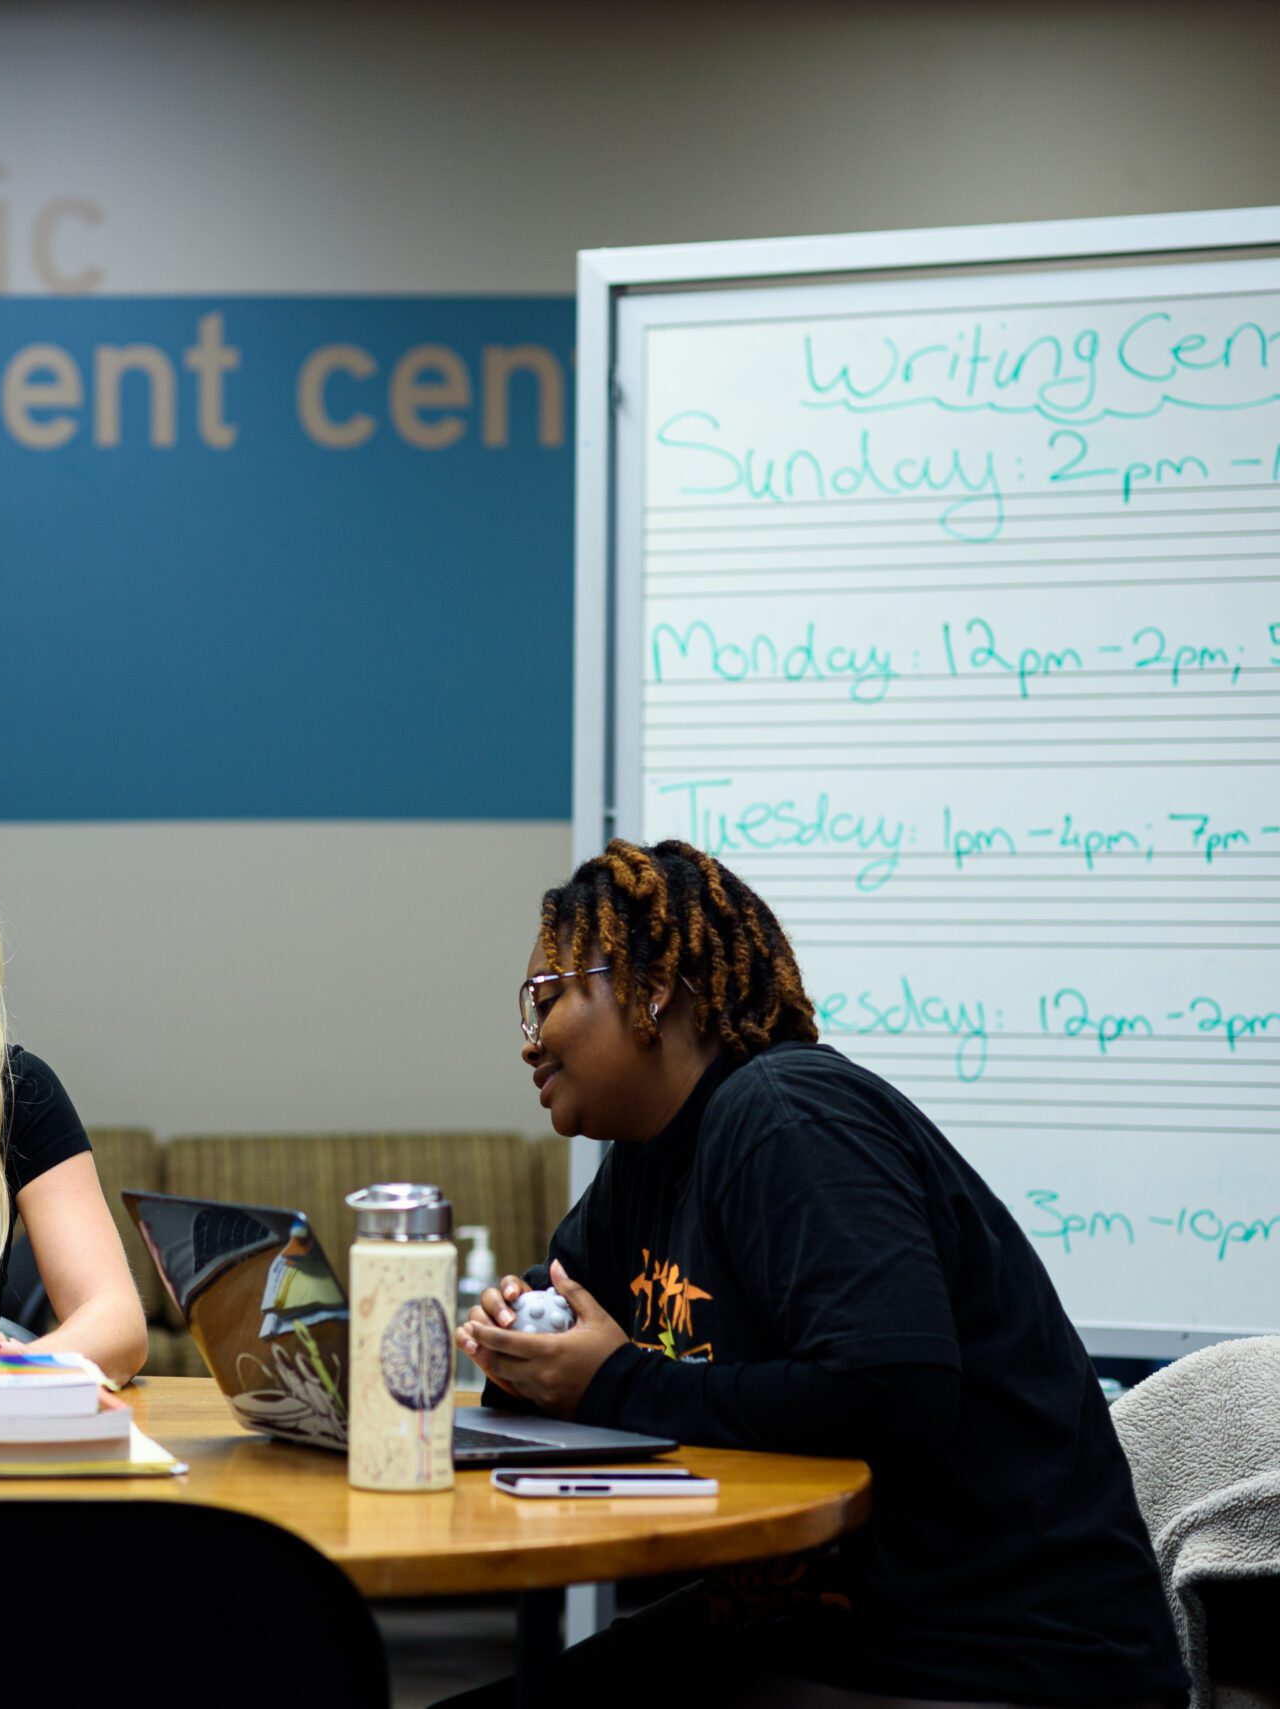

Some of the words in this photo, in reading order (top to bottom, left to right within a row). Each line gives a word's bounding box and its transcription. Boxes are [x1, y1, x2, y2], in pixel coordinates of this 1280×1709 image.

[296, 340, 576, 450] cen
[803, 322, 1099, 413] Writing
[1117, 311, 1280, 383] Cen
[657, 409, 1025, 545] Sunday:
[653, 620, 922, 704] Monday:
[658, 778, 917, 893] Tuesday:
[813, 974, 1004, 1084] esday:
